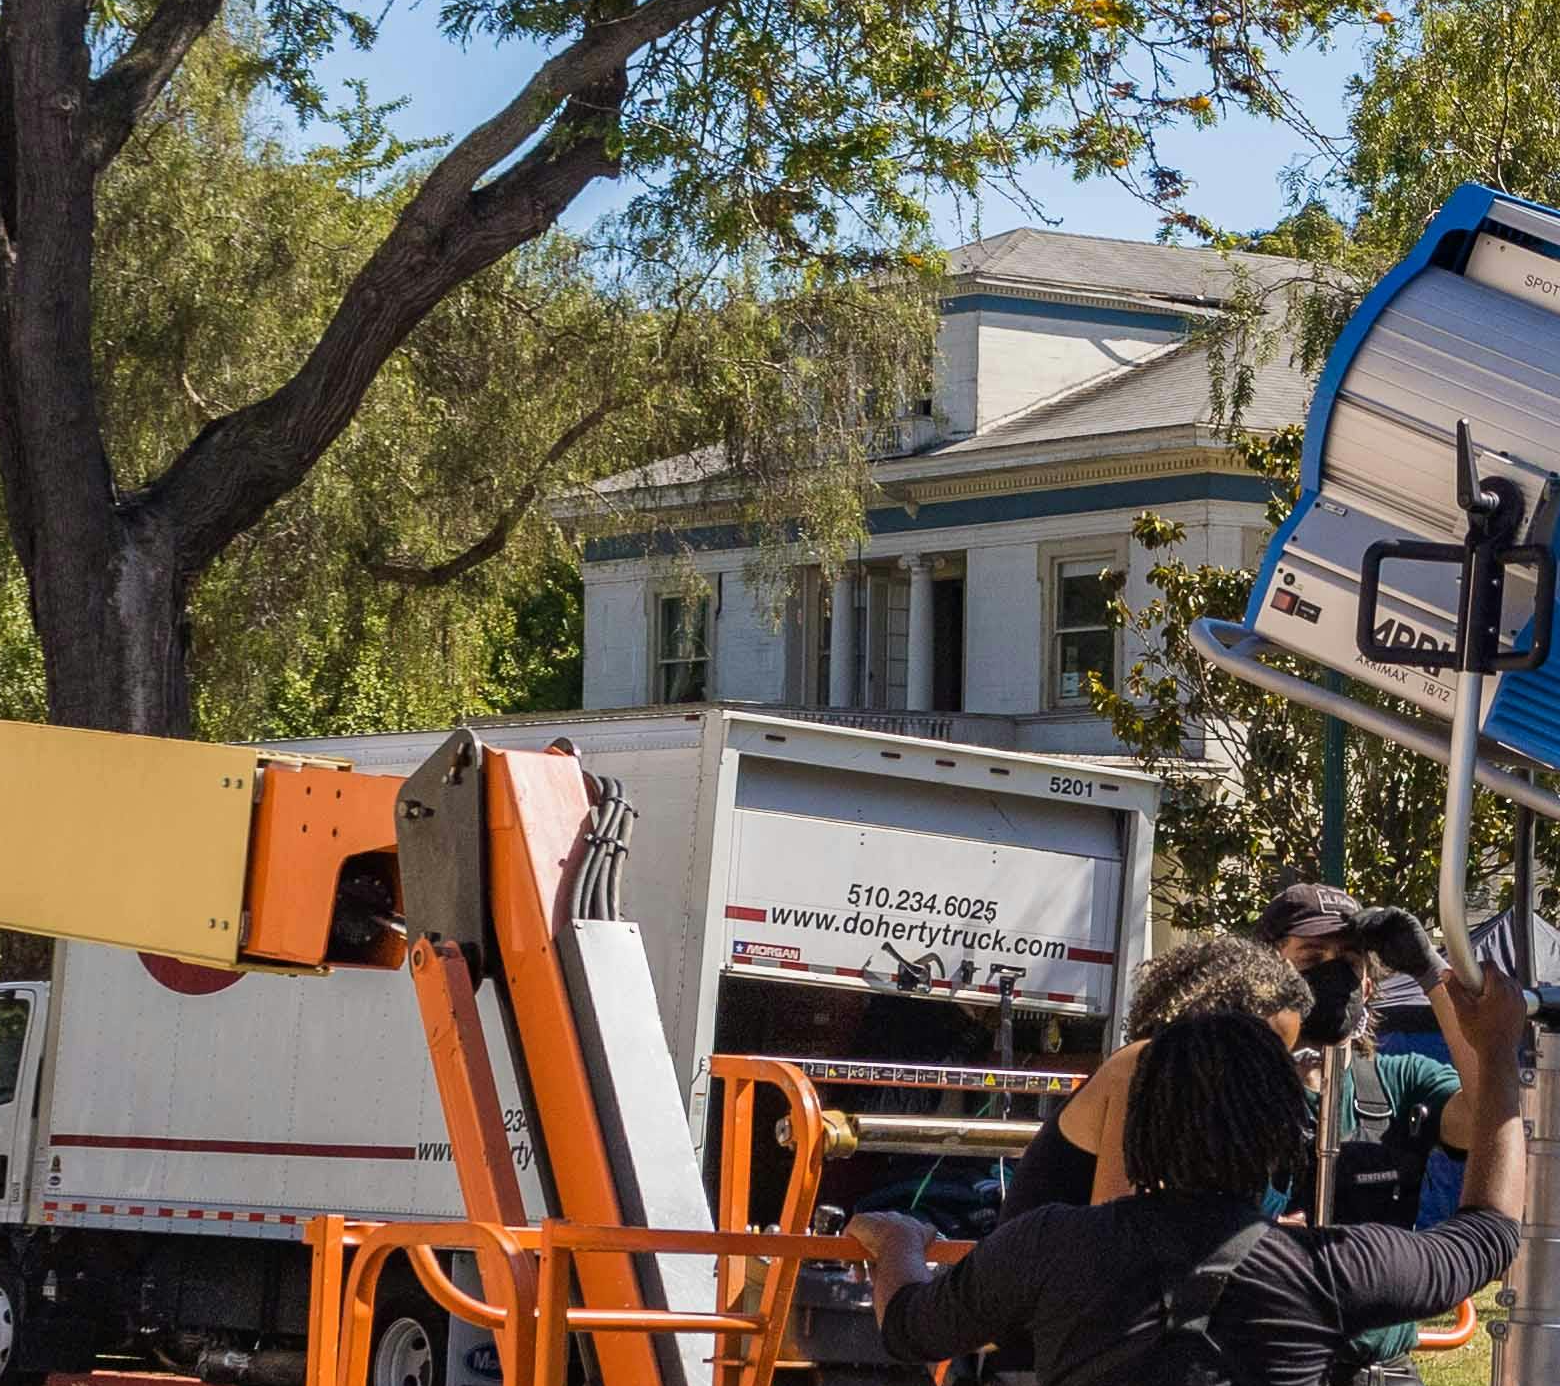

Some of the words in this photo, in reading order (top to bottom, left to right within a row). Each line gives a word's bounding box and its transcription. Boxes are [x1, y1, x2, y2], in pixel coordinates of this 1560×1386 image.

[1524, 274, 1560, 297] SPOT
[1423, 681, 1450, 702] 18/12
[1050, 776, 1093, 798] 5201
[847, 883, 999, 923] 510.234.6025
[771, 907, 1067, 960] www.dohertytruck.com
[746, 944, 799, 960] MORGAN
